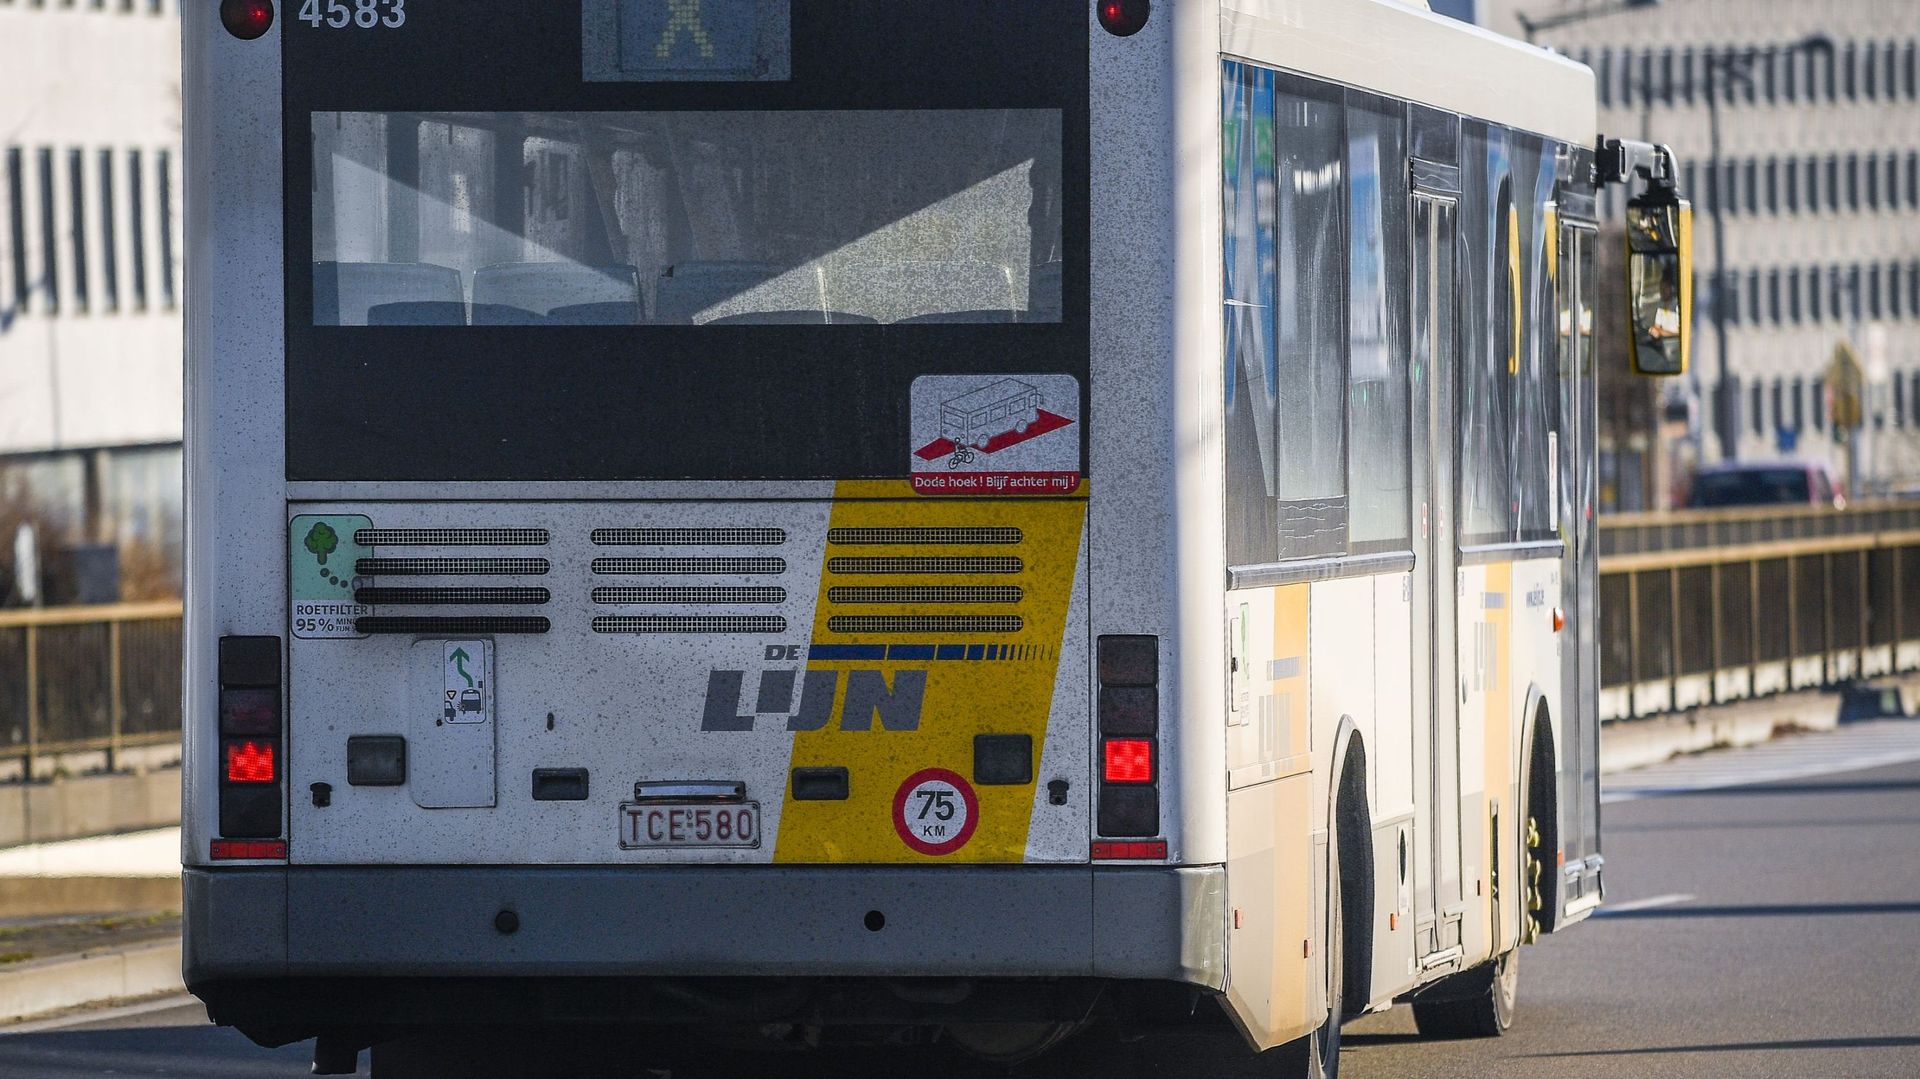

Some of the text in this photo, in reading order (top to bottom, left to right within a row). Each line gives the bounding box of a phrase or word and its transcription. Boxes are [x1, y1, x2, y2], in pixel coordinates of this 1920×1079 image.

[298, 0, 406, 28] 4583
[915, 477, 945, 487] Dode
[949, 476, 977, 487] hoek
[986, 476, 1008, 489] Blijf
[1010, 476, 1049, 487] achter
[1052, 477, 1069, 489] mij
[296, 605, 368, 615] ROETFILTER
[764, 644, 801, 661] DE
[700, 670, 928, 731] LIJN
[916, 790, 955, 821] 75
[923, 825, 945, 837] KM
